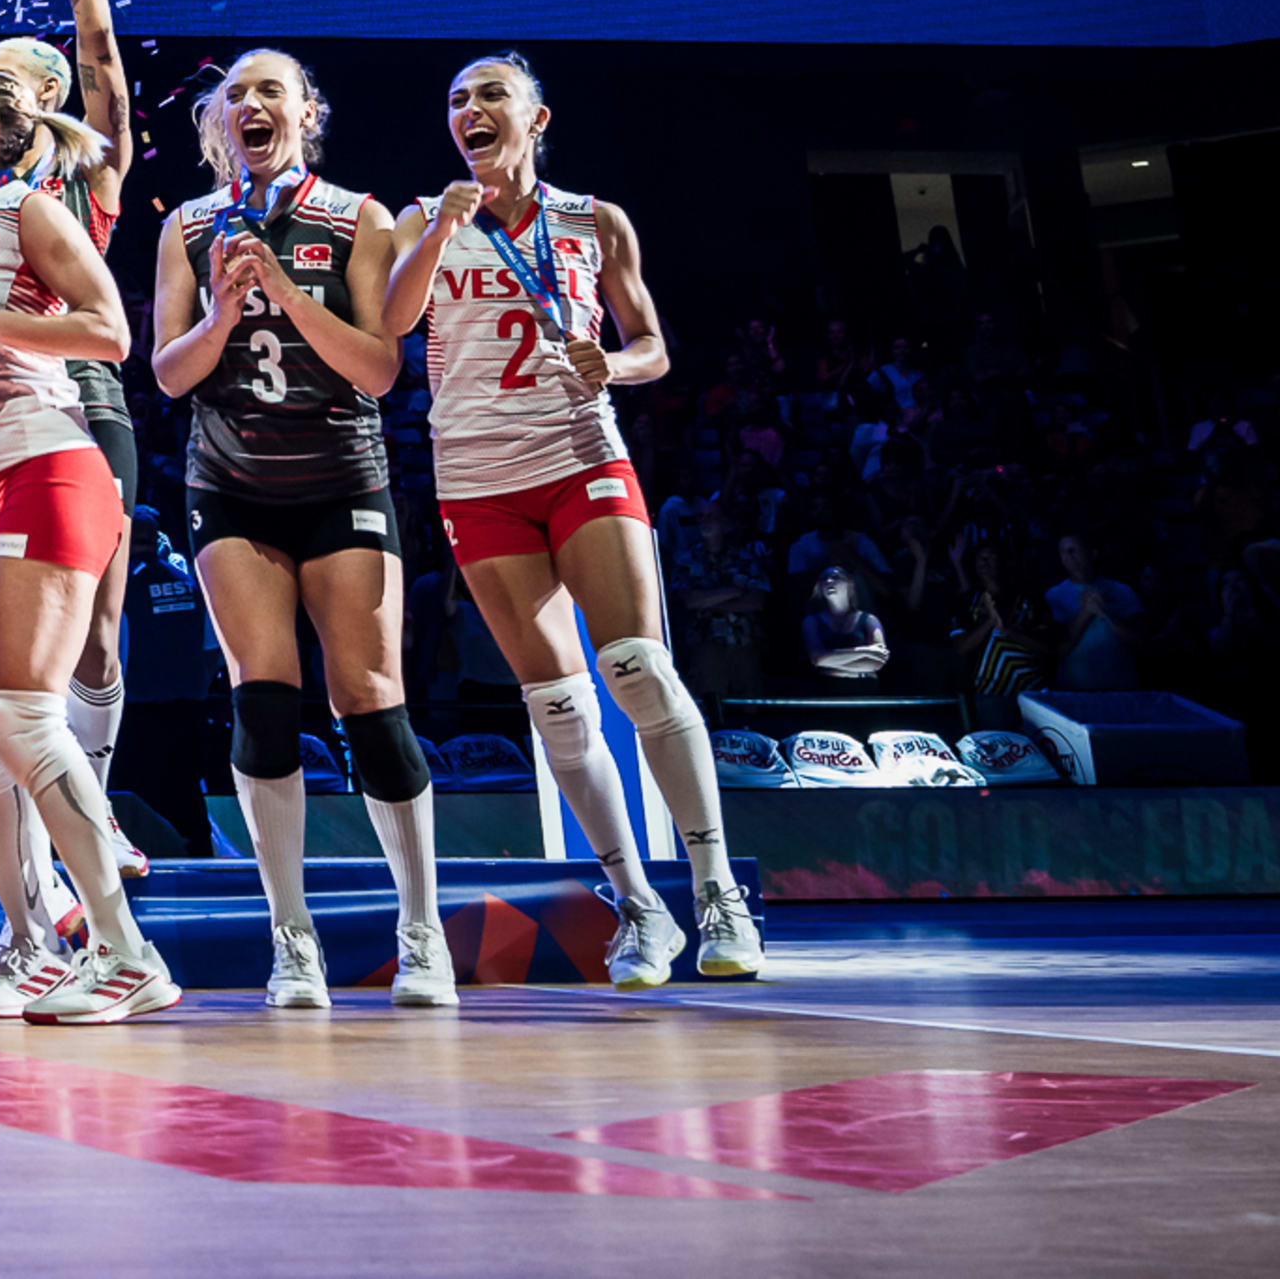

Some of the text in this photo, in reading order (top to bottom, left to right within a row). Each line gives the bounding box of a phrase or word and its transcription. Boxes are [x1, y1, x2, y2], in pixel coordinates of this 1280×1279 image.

[249, 329, 288, 404] 3
[497, 309, 537, 389] 2
[191, 509, 203, 531] 3
[443, 518, 459, 547] 2
